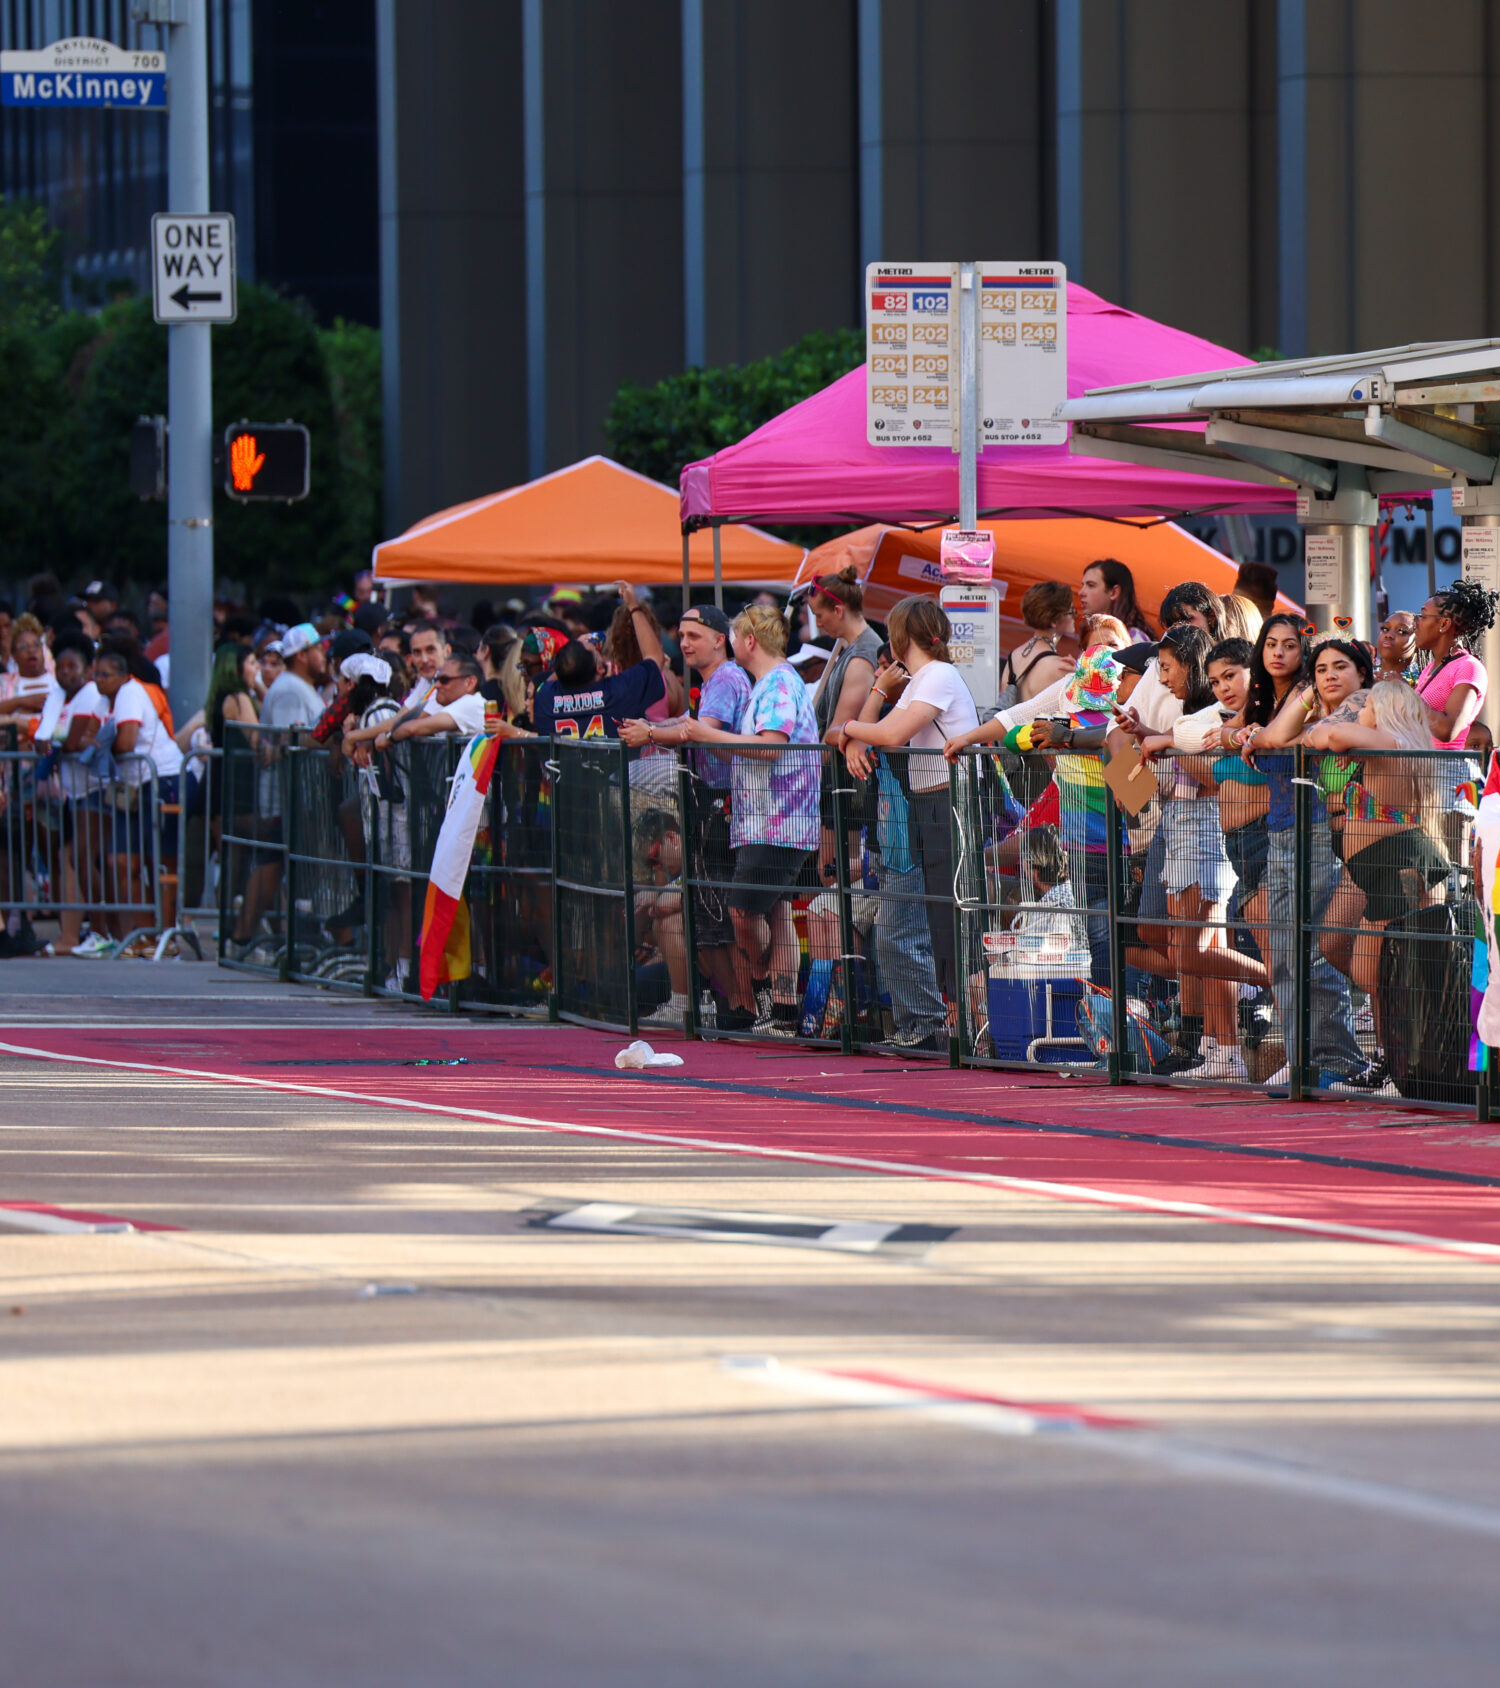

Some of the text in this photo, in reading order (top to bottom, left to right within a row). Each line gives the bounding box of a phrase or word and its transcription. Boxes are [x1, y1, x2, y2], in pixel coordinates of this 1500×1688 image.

[54, 41, 107, 53] SKYLINE
[54, 57, 110, 66] DISTRICT
[132, 55, 160, 68] 700
[13, 73, 153, 105] McKinney
[165, 224, 222, 248] ONE
[163, 254, 223, 277] WAY
[884, 296, 906, 309] 82
[916, 296, 947, 309] 102
[982, 295, 1015, 308] 246
[1023, 295, 1055, 308] 247
[876, 327, 906, 340] 108
[914, 327, 947, 340] 202
[982, 326, 1015, 339] 248
[1023, 326, 1055, 339] 249
[873, 358, 906, 371] 204
[914, 358, 947, 371] 209
[873, 389, 907, 402] 236
[914, 389, 947, 402] 244
[1371, 381, 1378, 398] E
[951, 624, 973, 635] 102
[950, 647, 973, 658] 108
[553, 690, 604, 713] PRIDE
